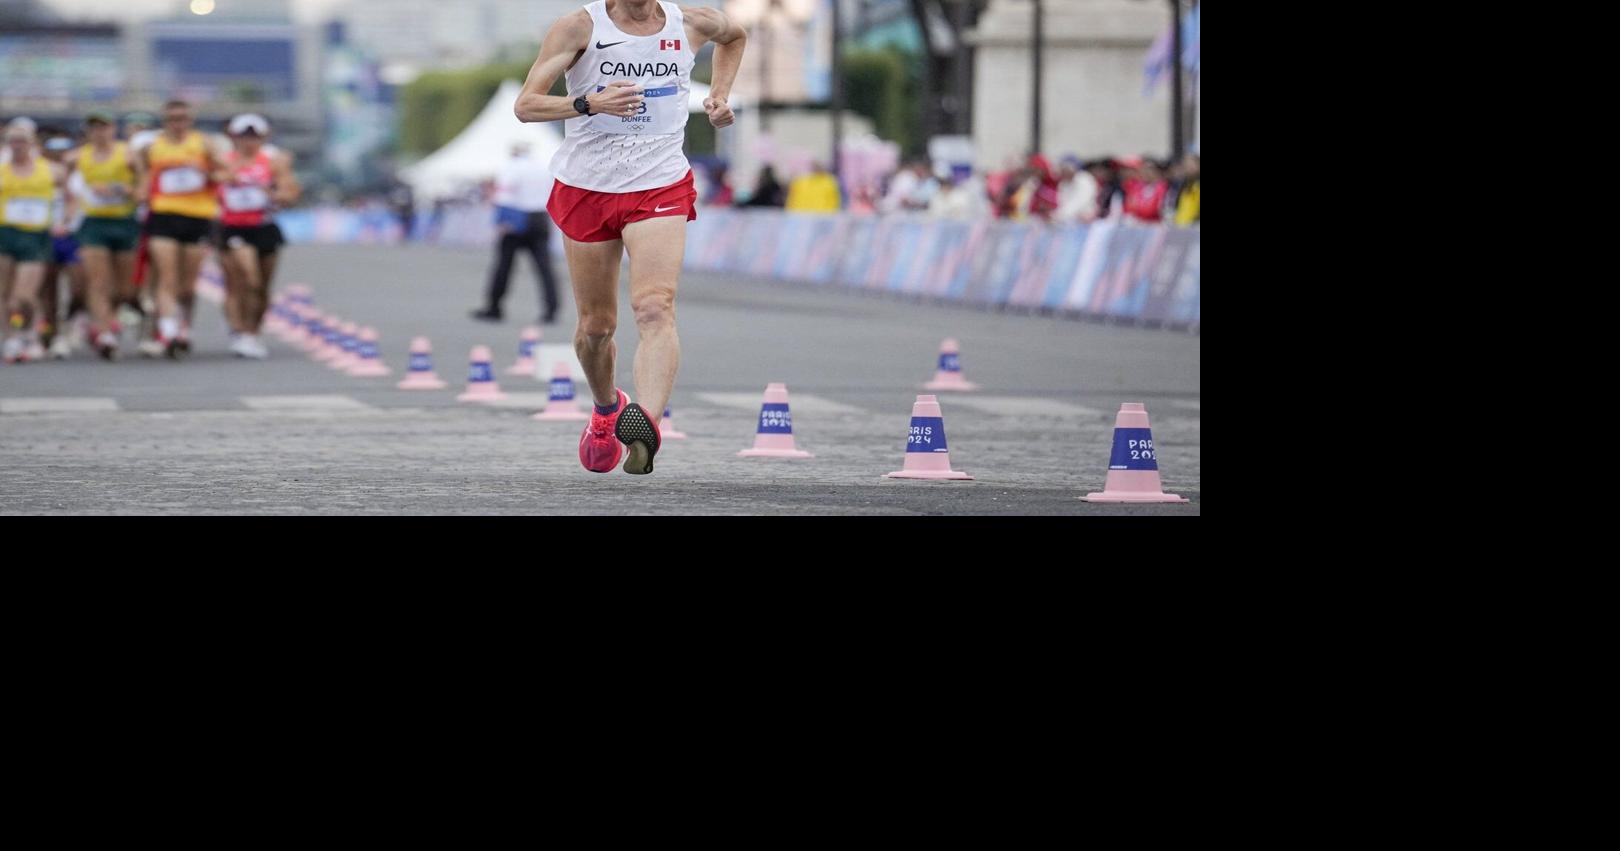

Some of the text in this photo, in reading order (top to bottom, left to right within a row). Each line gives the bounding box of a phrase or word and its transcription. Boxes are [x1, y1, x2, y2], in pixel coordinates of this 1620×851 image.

[600, 61, 679, 77] CANADA
[637, 101, 647, 115] 3
[621, 115, 652, 123] DUNFEE
[908, 435, 931, 444] 024
[1128, 439, 1152, 449] PAR
